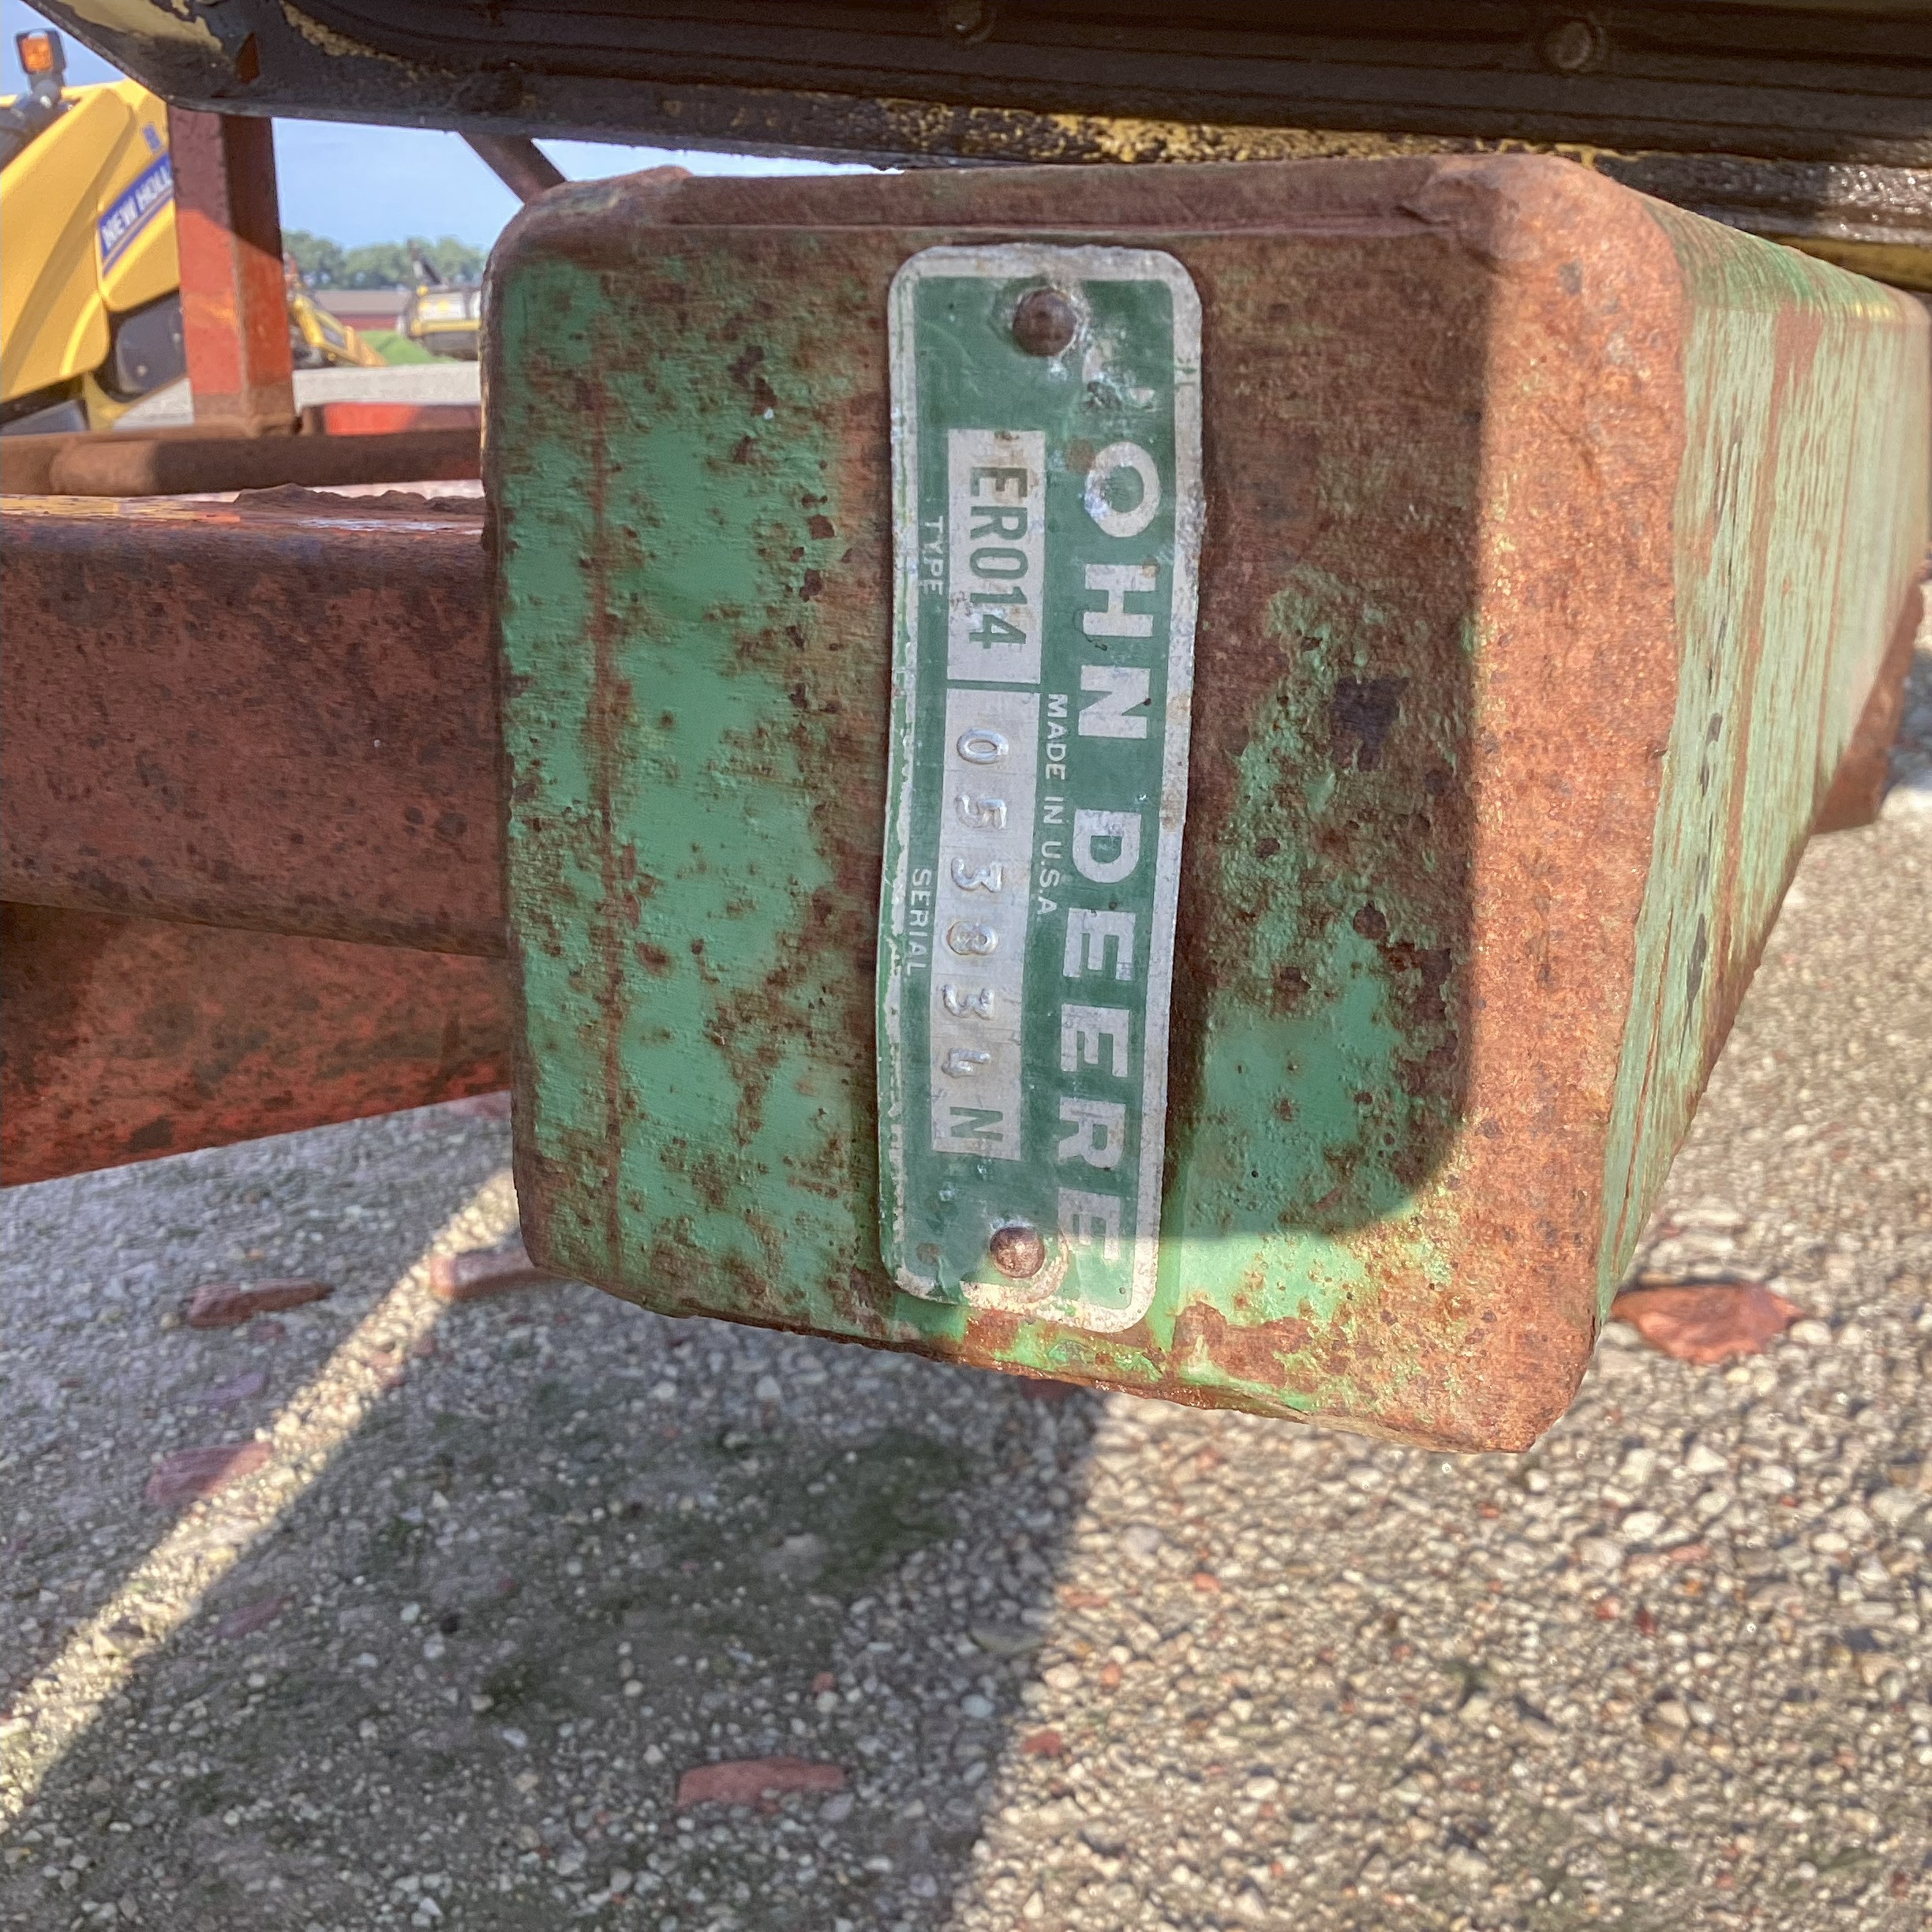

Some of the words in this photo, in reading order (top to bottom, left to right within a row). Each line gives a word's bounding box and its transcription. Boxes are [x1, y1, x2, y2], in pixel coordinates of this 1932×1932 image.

[102, 196, 138, 251] NEW
[918, 515, 944, 596] TYPE
[968, 467, 1028, 650] ER014
[1045, 694, 1068, 781] MADE
[1043, 796, 1065, 825] IN
[906, 868, 932, 975] SERIAL
[1058, 809, 1141, 1261] DEERE
